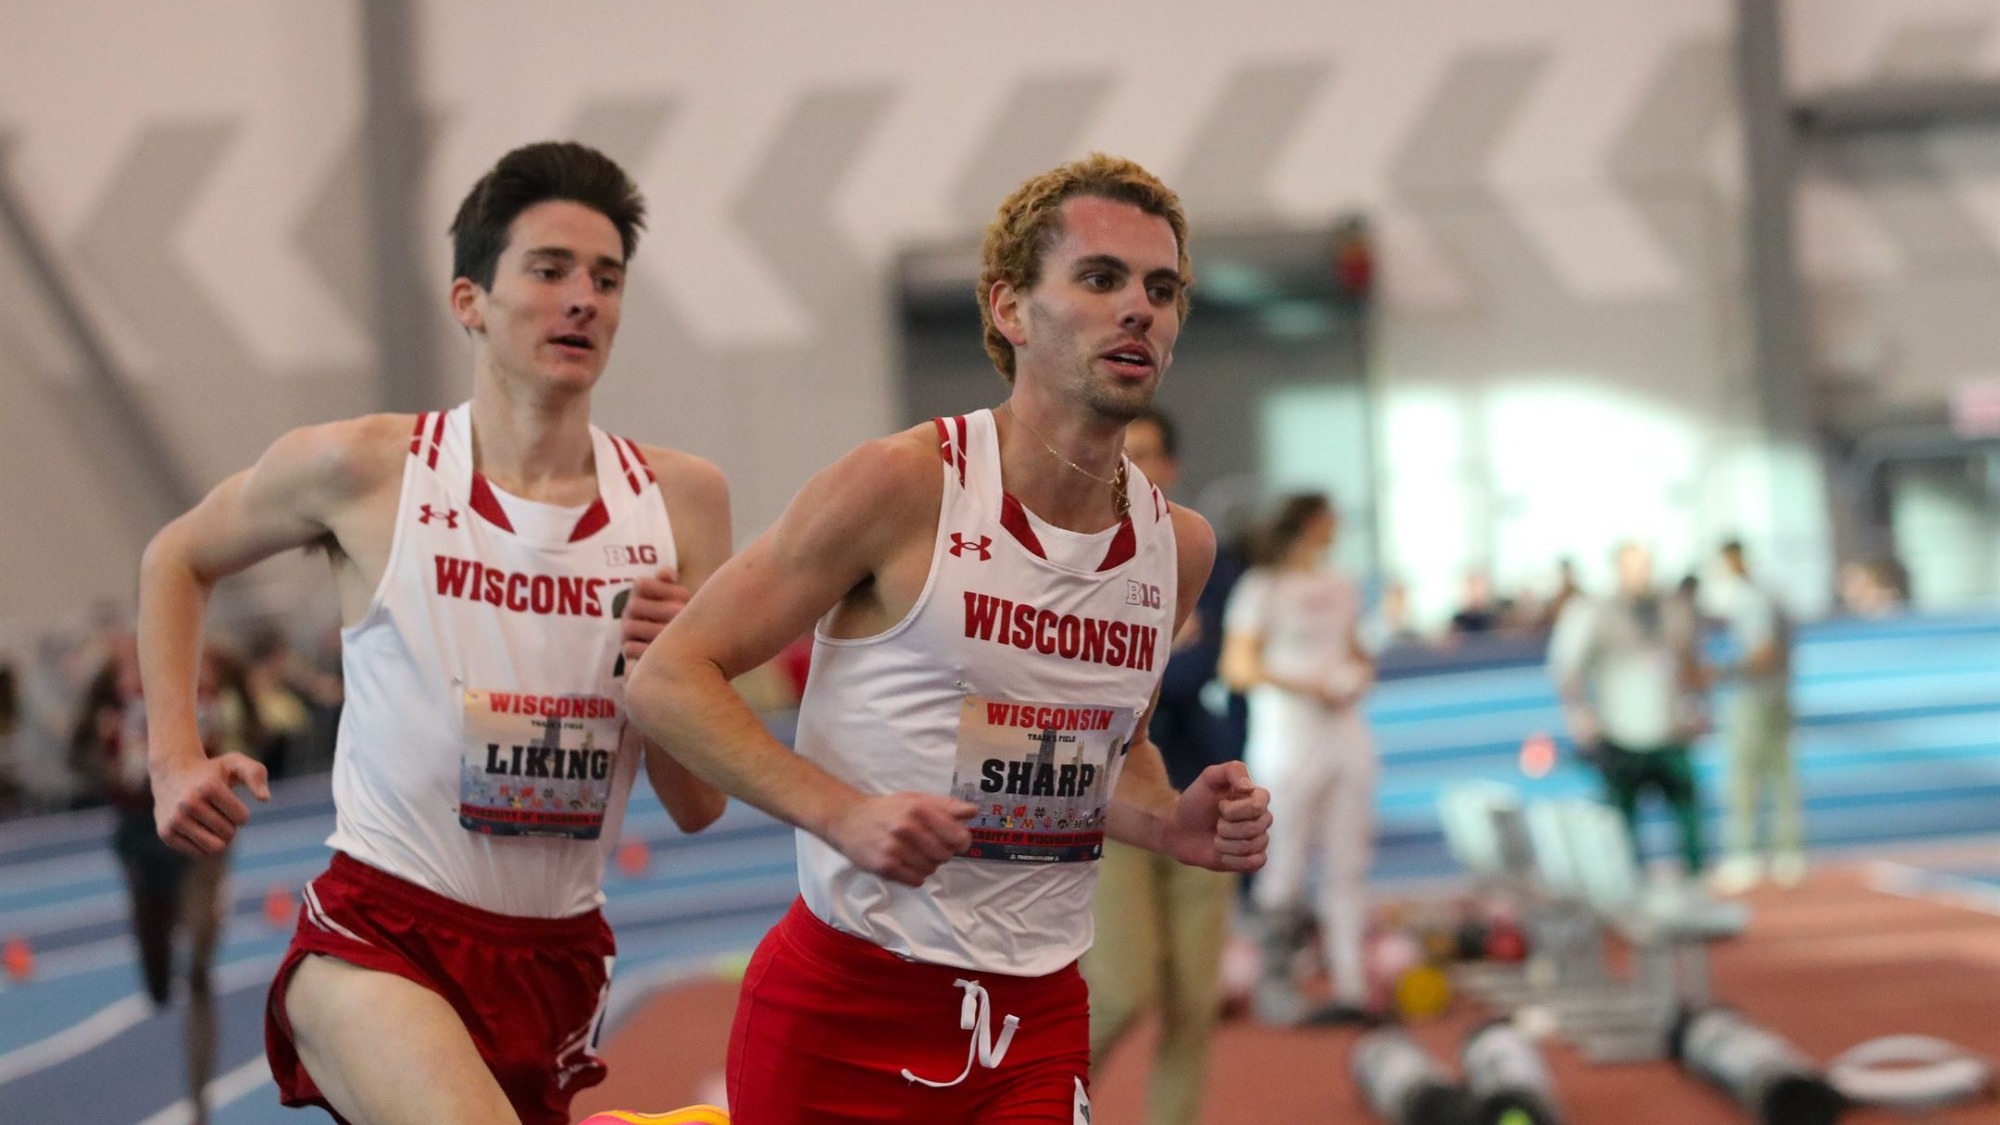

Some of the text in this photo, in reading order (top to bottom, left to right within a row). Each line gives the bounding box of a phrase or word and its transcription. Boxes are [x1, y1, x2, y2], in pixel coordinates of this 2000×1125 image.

[434, 555, 635, 618] WISCONS
[963, 591, 1158, 672] WISCONSIN
[489, 692, 616, 718] WISCONSIN
[986, 702, 1115, 731] WISCONSIN
[485, 743, 609, 780] LIKING
[980, 758, 1095, 797] SHARP
